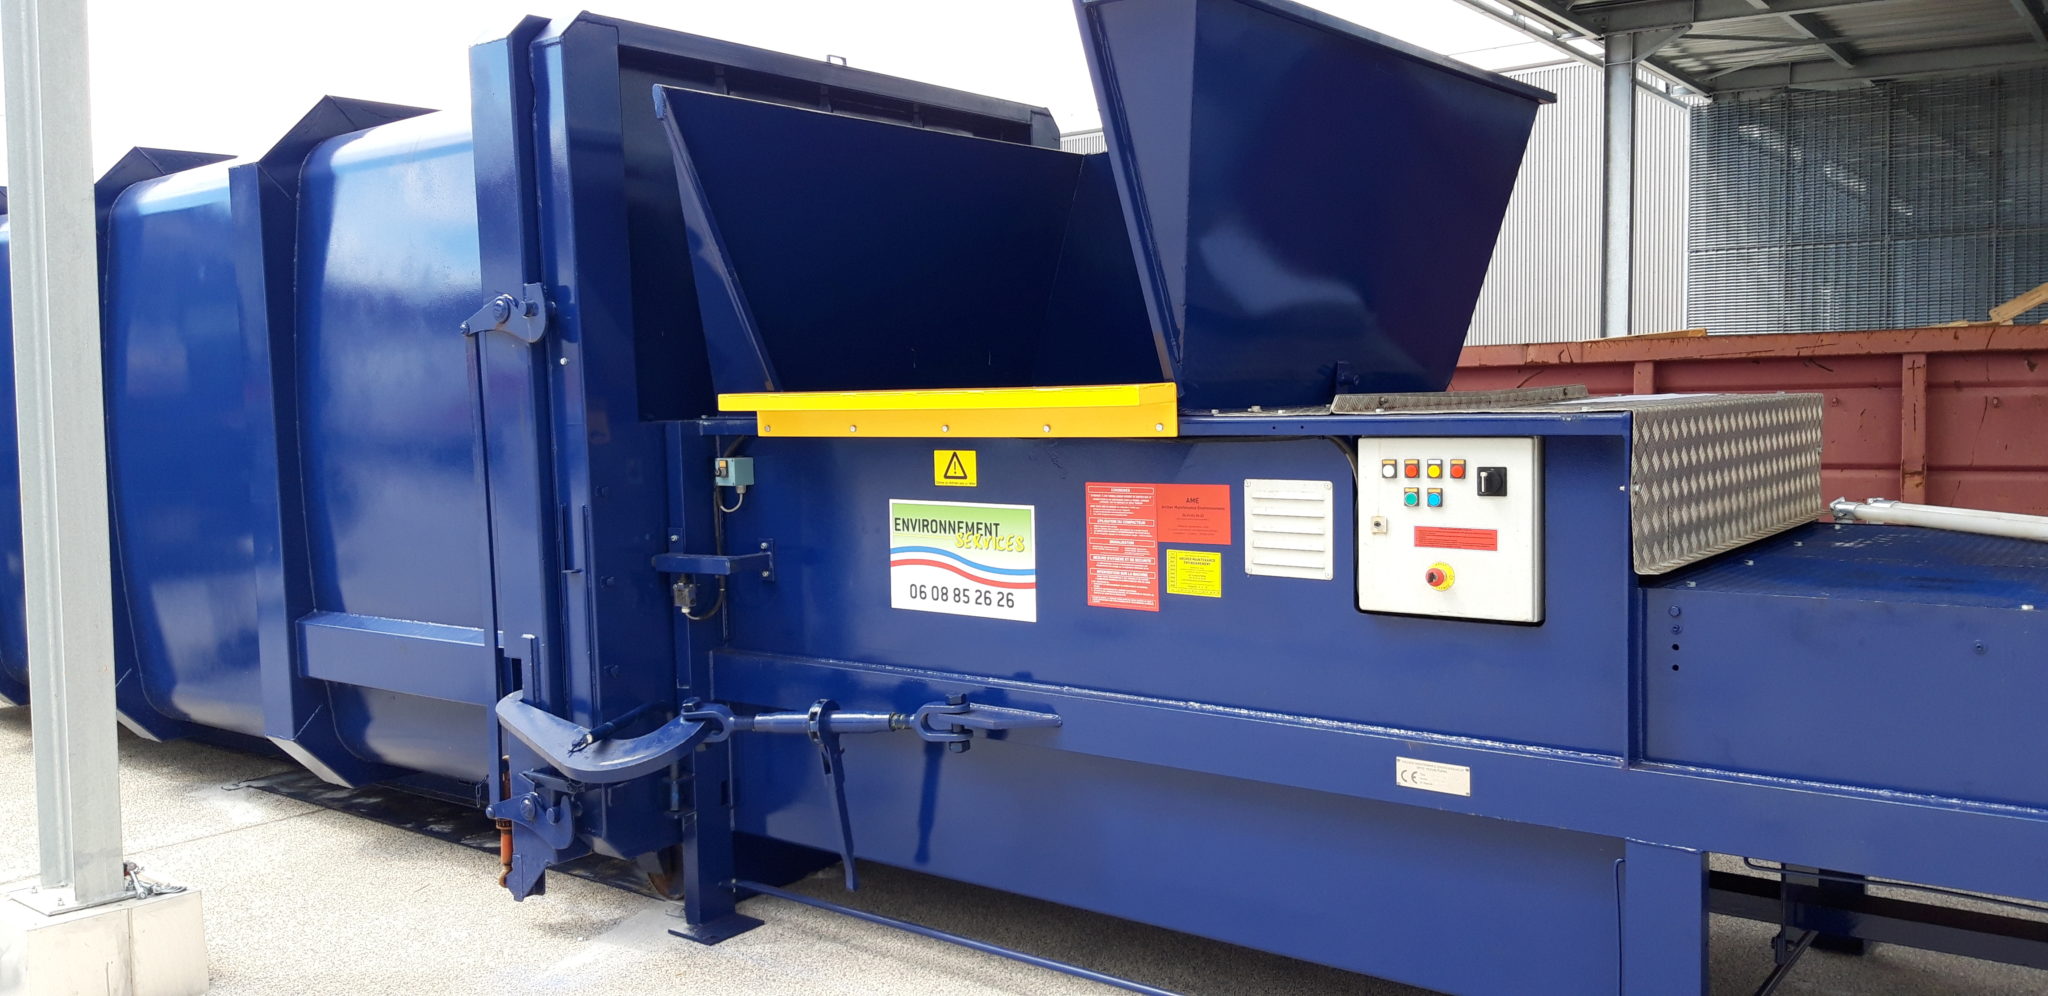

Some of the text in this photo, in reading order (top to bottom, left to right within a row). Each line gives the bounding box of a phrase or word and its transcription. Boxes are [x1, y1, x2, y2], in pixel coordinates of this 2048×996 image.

[894, 517, 1001, 538] ENVIRONNEMENT
[954, 531, 1025, 552] SERVICES
[909, 583, 1015, 609] 06 08 85 26 26
